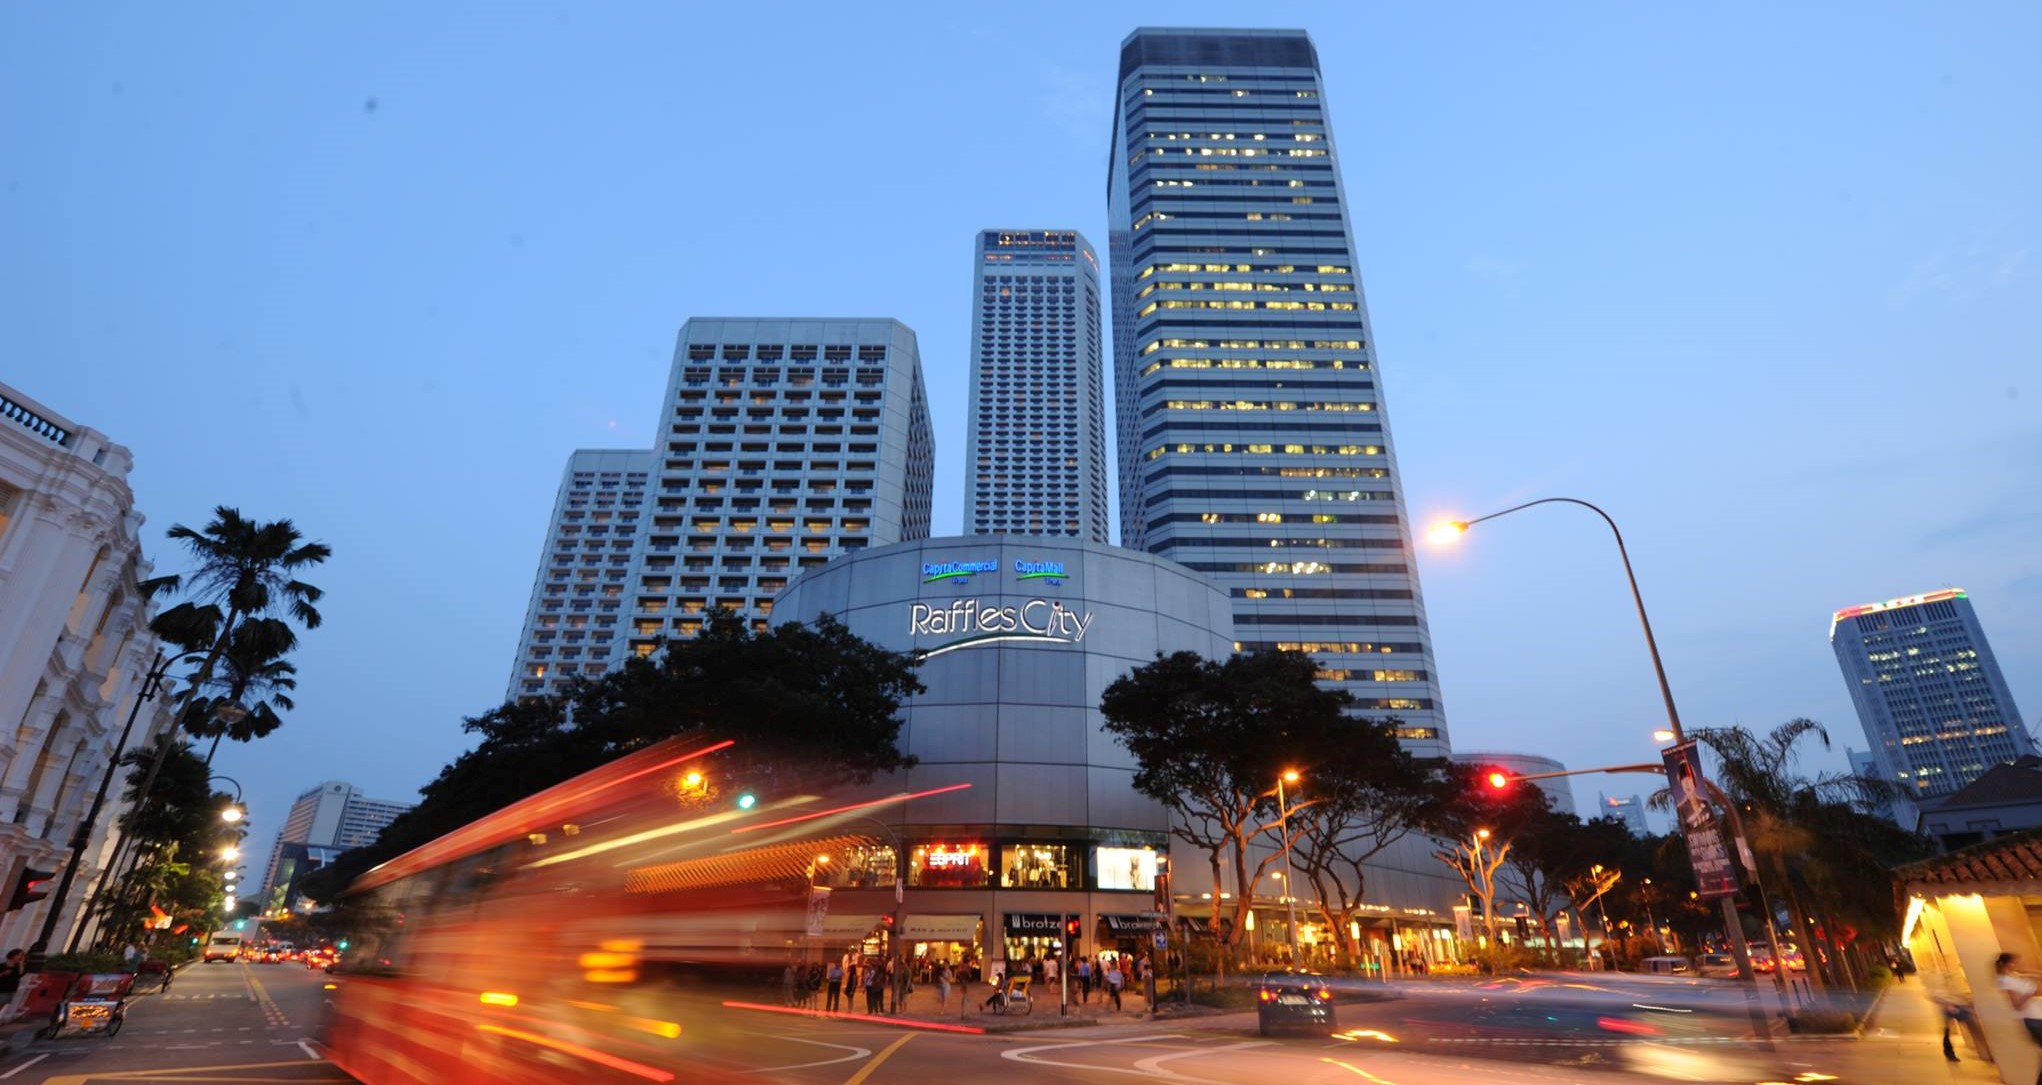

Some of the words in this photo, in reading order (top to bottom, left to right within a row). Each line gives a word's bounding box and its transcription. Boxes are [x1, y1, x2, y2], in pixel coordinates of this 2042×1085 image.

[1015, 558, 1064, 575] CapitaMall
[909, 600, 1017, 635] Raffles
[1020, 600, 1092, 642] City
[929, 852, 970, 866] ESPRIT
